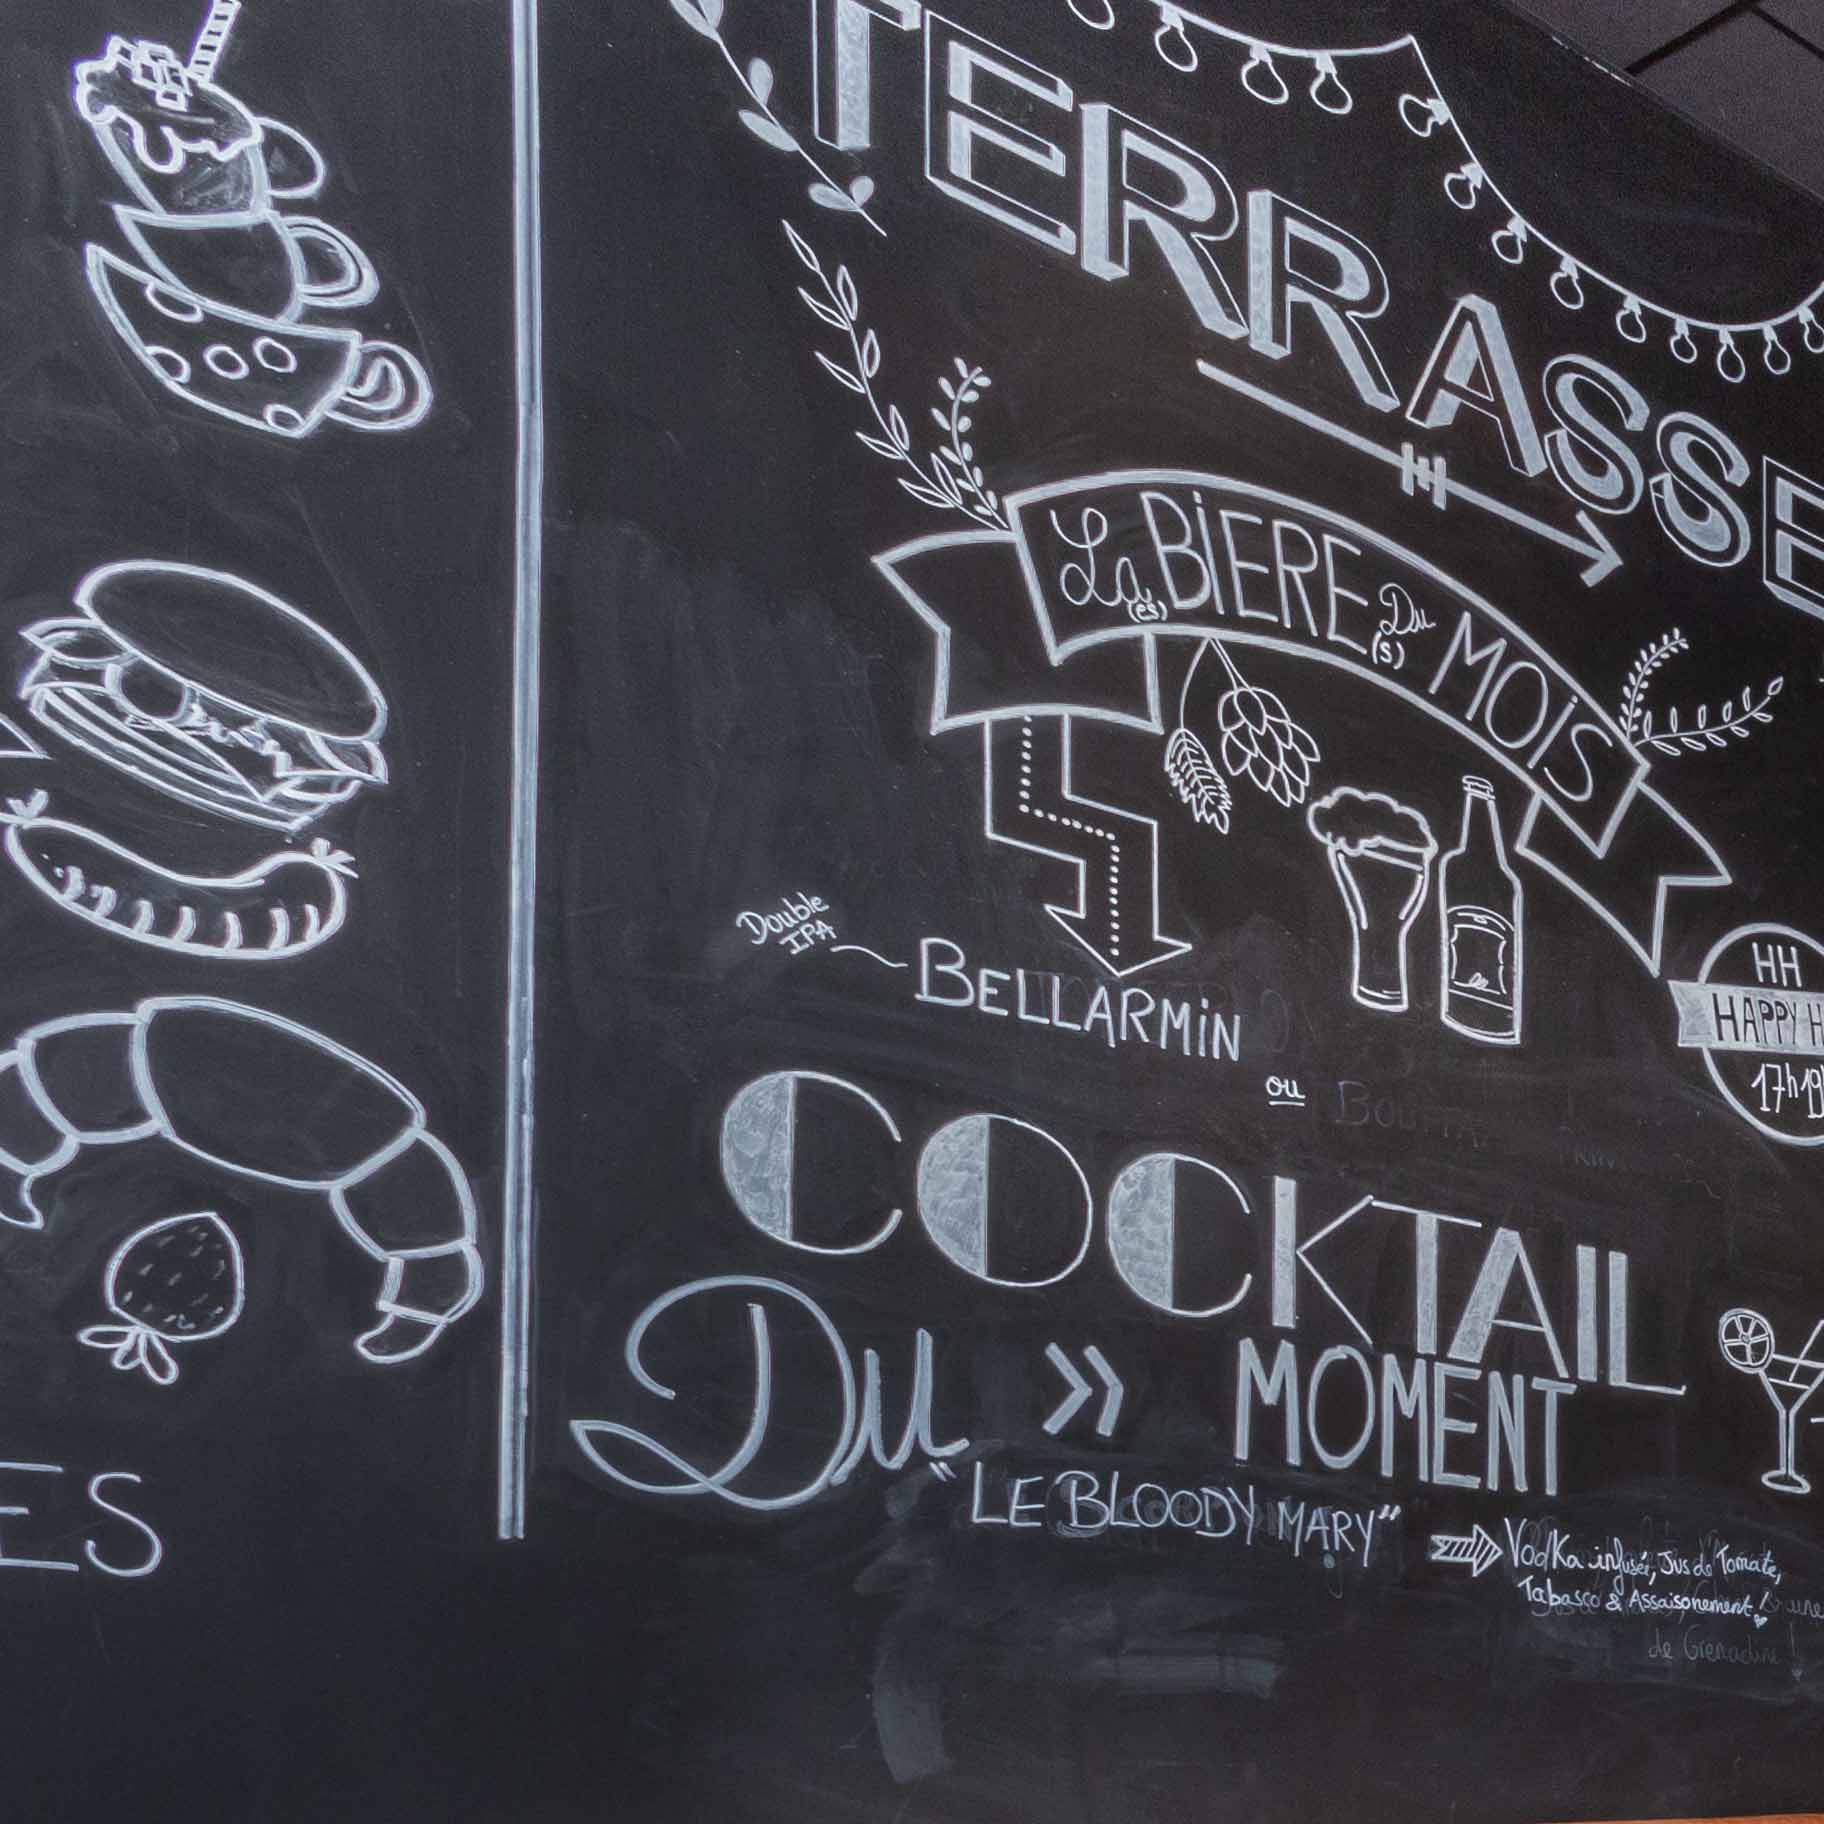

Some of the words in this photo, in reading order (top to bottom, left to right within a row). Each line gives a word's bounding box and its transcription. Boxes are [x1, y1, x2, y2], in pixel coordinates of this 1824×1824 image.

[1377, 582, 1436, 636] Du
[735, 890, 830, 945] Double
[779, 918, 837, 955] IPA
[1752, 942, 1802, 987] HH
[1712, 992, 1797, 1045] HAPPY
[719, 1069, 1687, 1396] COCKTAIL
[568, 1275, 969, 1510] Du
[1235, 1337, 1577, 1495] MOMENT
[1055, 1471, 1256, 1545] BLOODY
[1517, 1575, 1600, 1607] Tabasco
